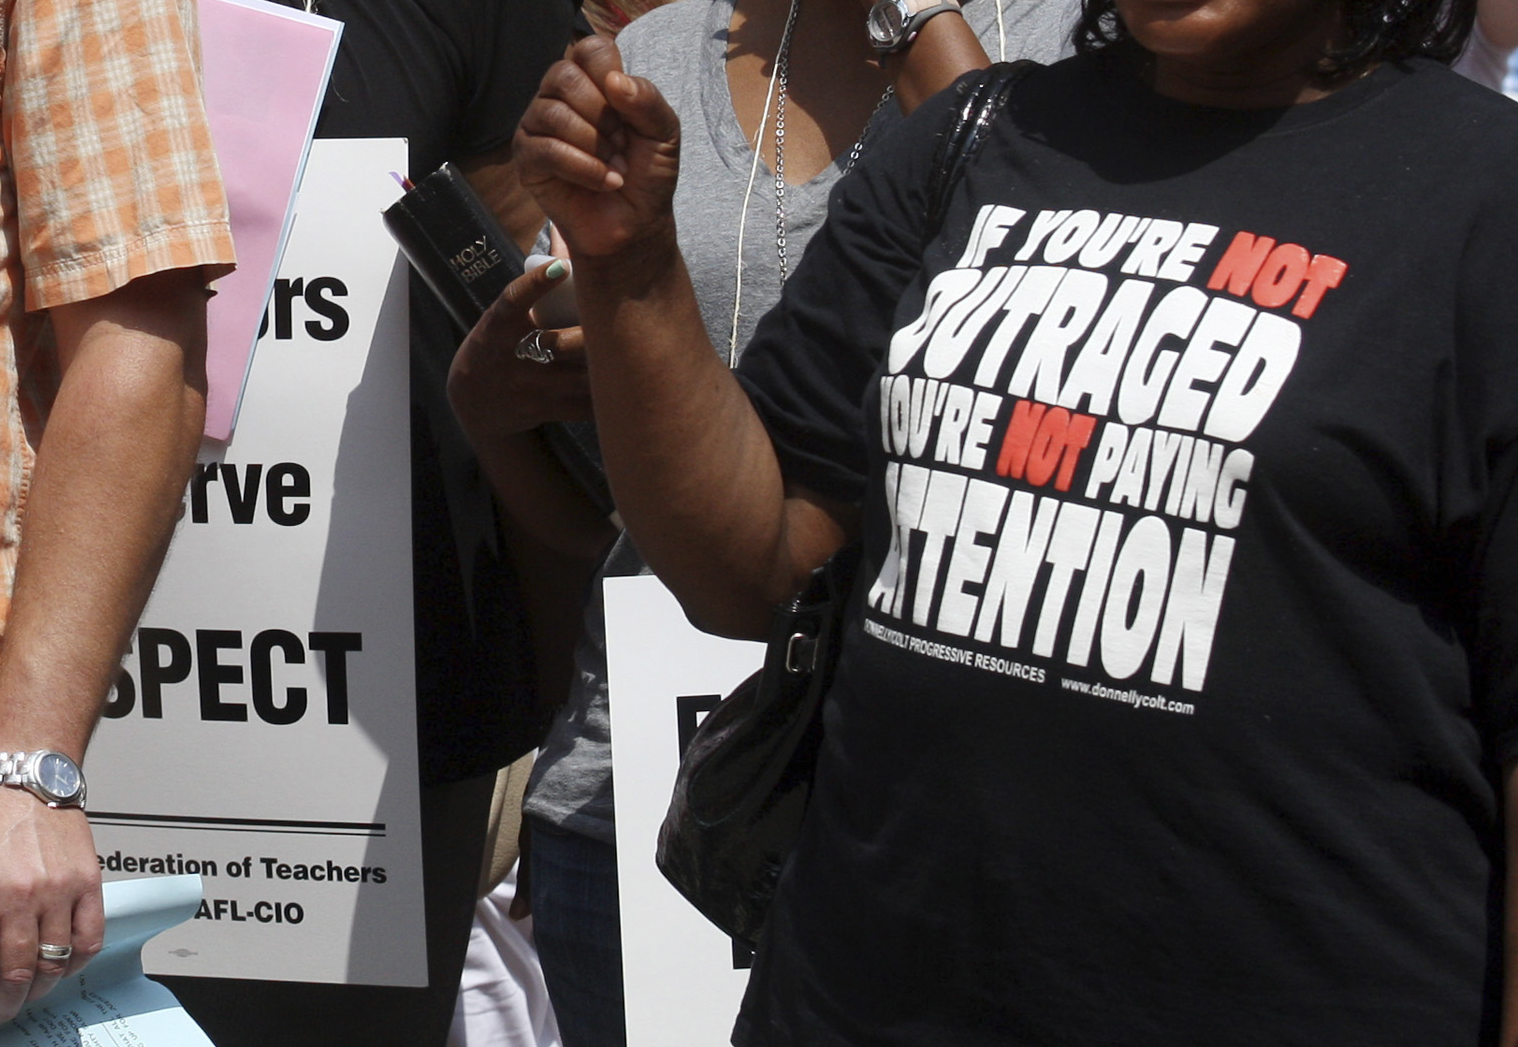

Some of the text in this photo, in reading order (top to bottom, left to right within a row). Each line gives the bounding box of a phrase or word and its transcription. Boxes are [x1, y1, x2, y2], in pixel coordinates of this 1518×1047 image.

[449, 235, 488, 270] HOLY
[461, 249, 502, 284] BIBLE
[955, 204, 1349, 320] IF YOU'RE NOT
[888, 265, 1302, 443] OUTRAGED
[880, 375, 1255, 529] YOU'RE NOT PAYING
[867, 461, 1236, 692] ATTENTION
[909, 636, 975, 666] PROGRESSIVE
[974, 653, 1046, 684] RESOURCES
[1061, 677, 1195, 716] www.donnellycolt.com
[95, 851, 388, 885] ederation of Teachers
[194, 899, 305, 925] AFL-CIO
